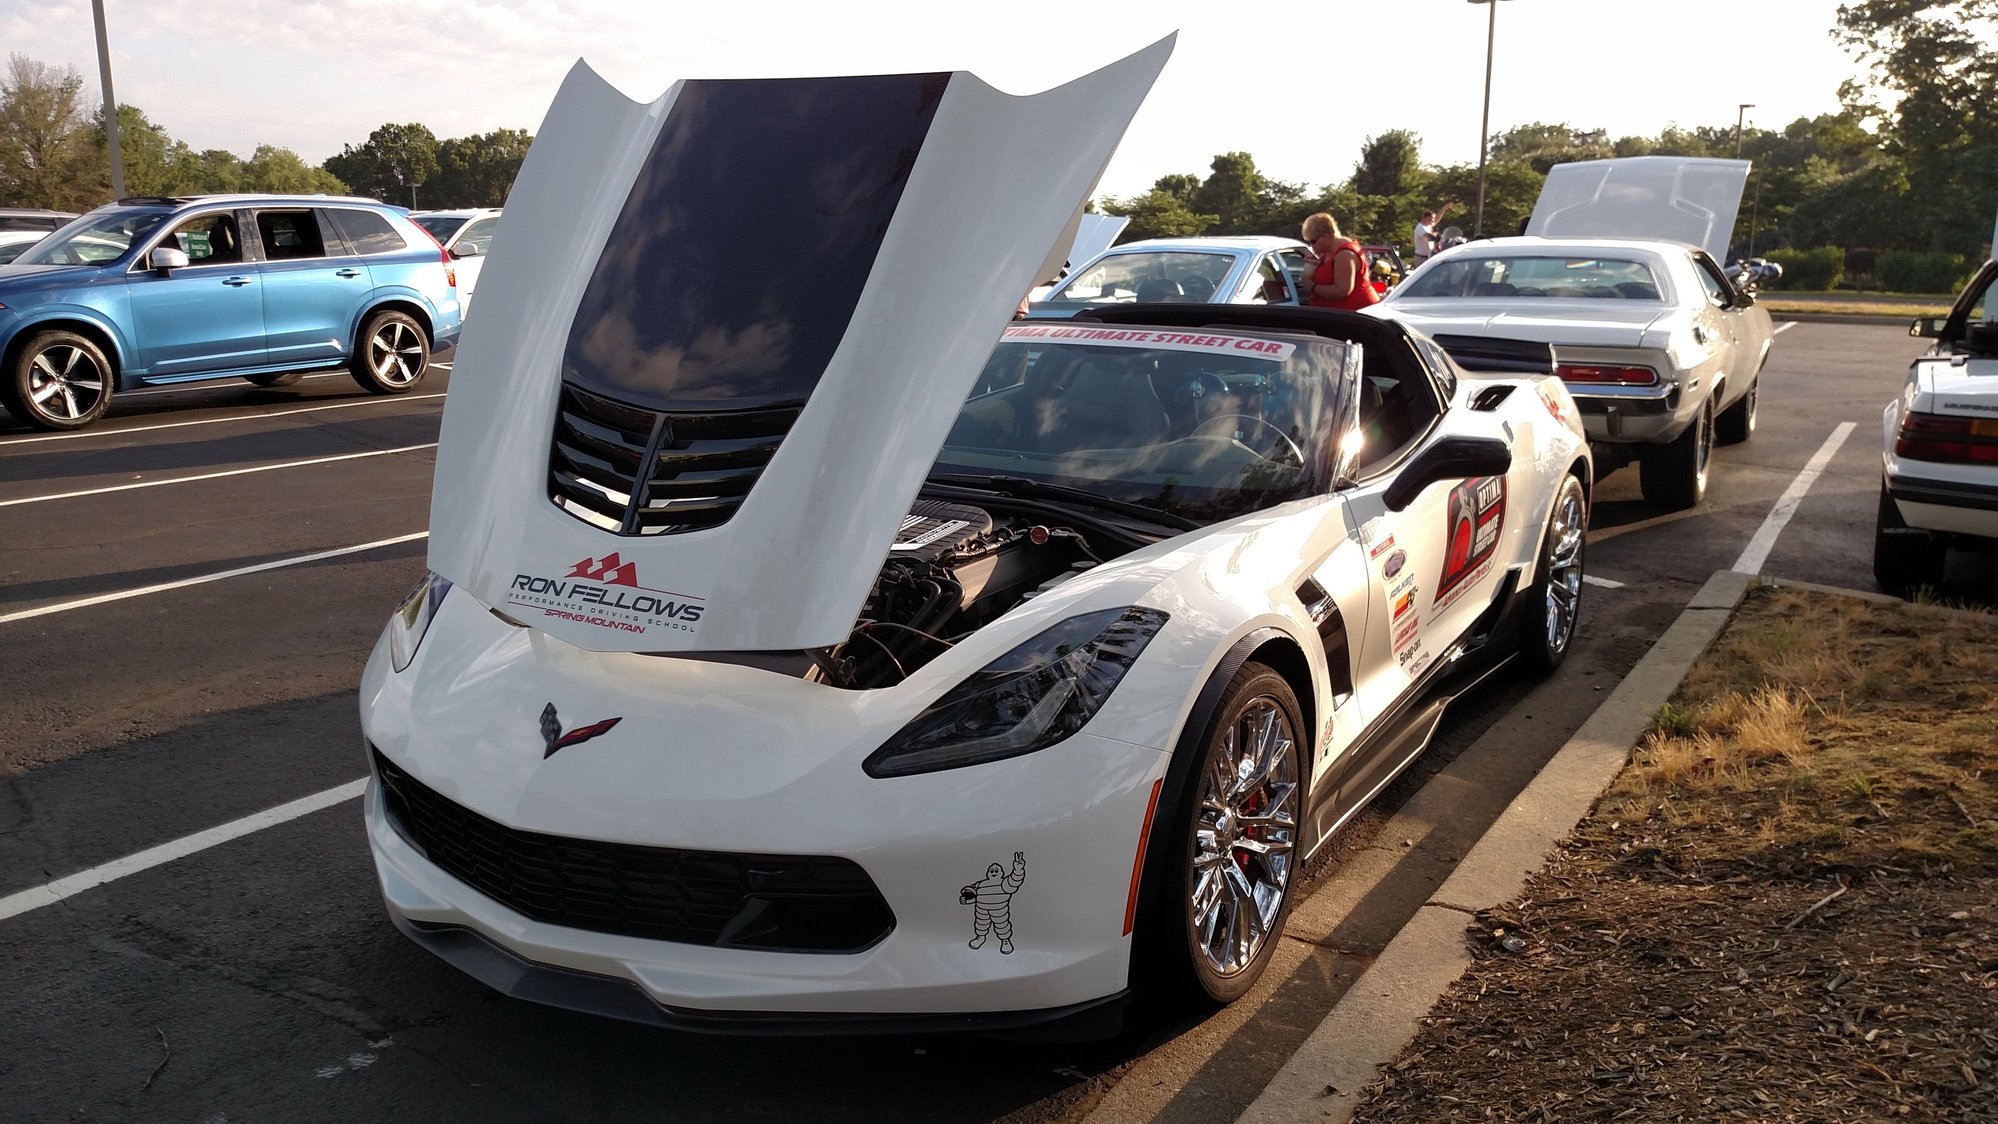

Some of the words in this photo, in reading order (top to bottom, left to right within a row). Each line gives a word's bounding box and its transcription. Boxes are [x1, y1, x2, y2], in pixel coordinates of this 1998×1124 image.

[1004, 327, 1051, 337] TIMA
[1050, 328, 1153, 342] ULTIMATE
[1151, 332, 1235, 348] STREET
[1234, 339, 1283, 354] CAR
[509, 592, 583, 611] PERFORMANCE
[590, 607, 639, 621] DRIVING
[647, 618, 695, 633] SCHOOL
[510, 574, 567, 597] RON
[567, 584, 705, 622] FELLOWS
[544, 608, 585, 622] SPRING
[584, 616, 646, 634] MOUNTAIN
[1399, 638, 1422, 667] Snap-on
